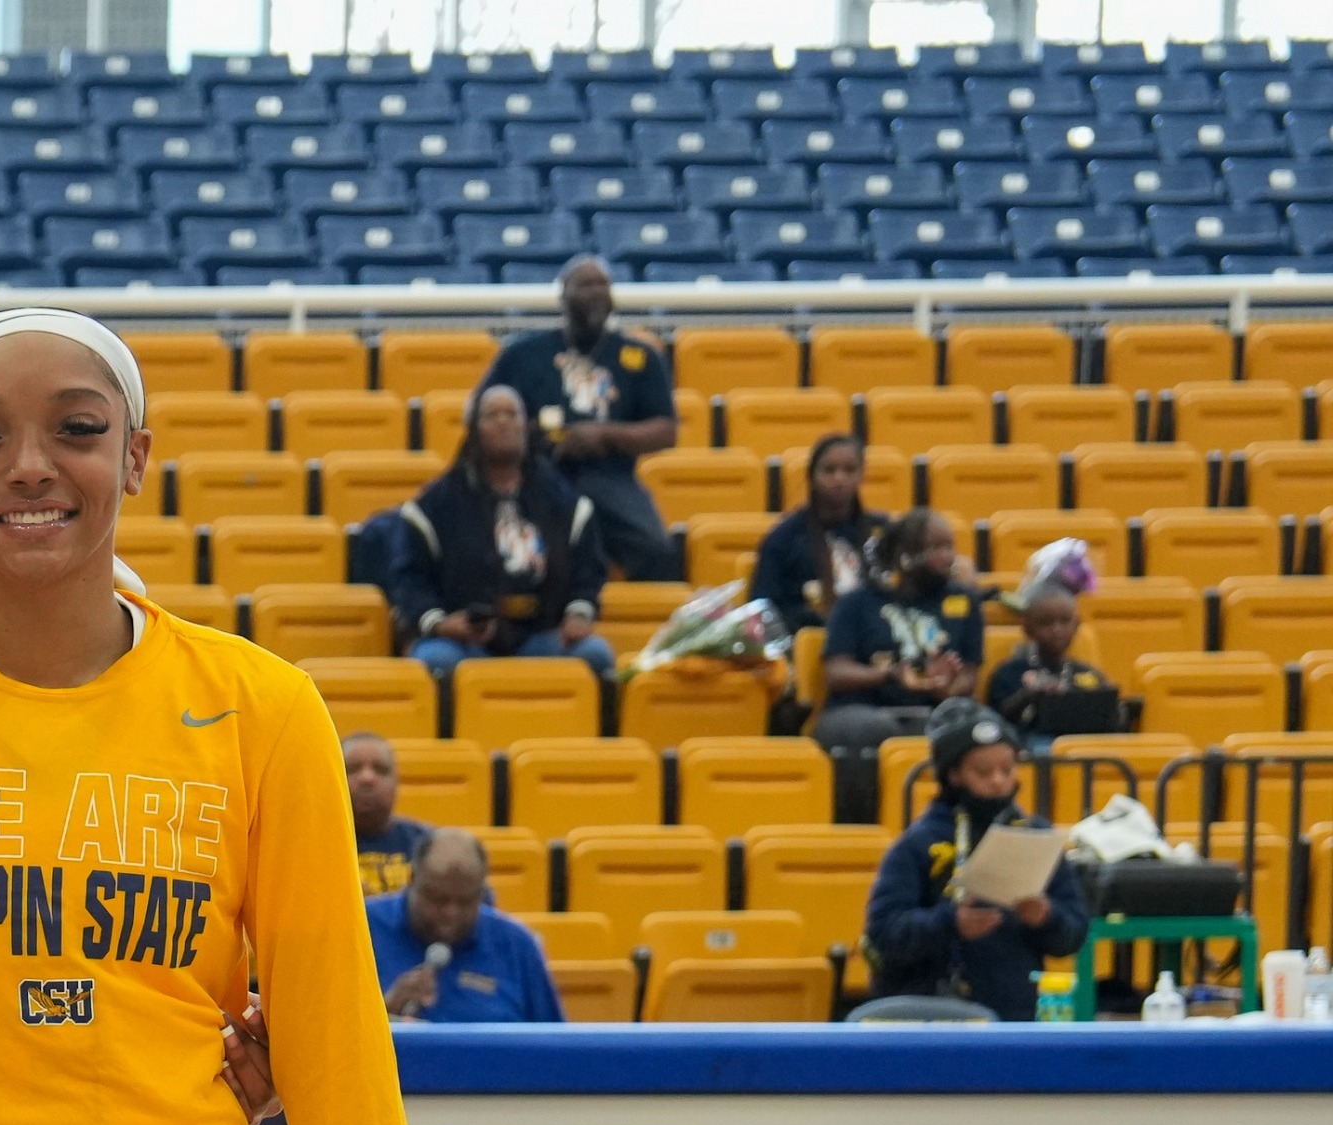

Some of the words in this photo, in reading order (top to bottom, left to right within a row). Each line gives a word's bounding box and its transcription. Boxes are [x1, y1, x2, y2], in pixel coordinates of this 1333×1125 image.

[57, 772, 229, 878] ARE
[81, 869, 212, 969] STATE
[18, 978, 95, 1026] CSU
